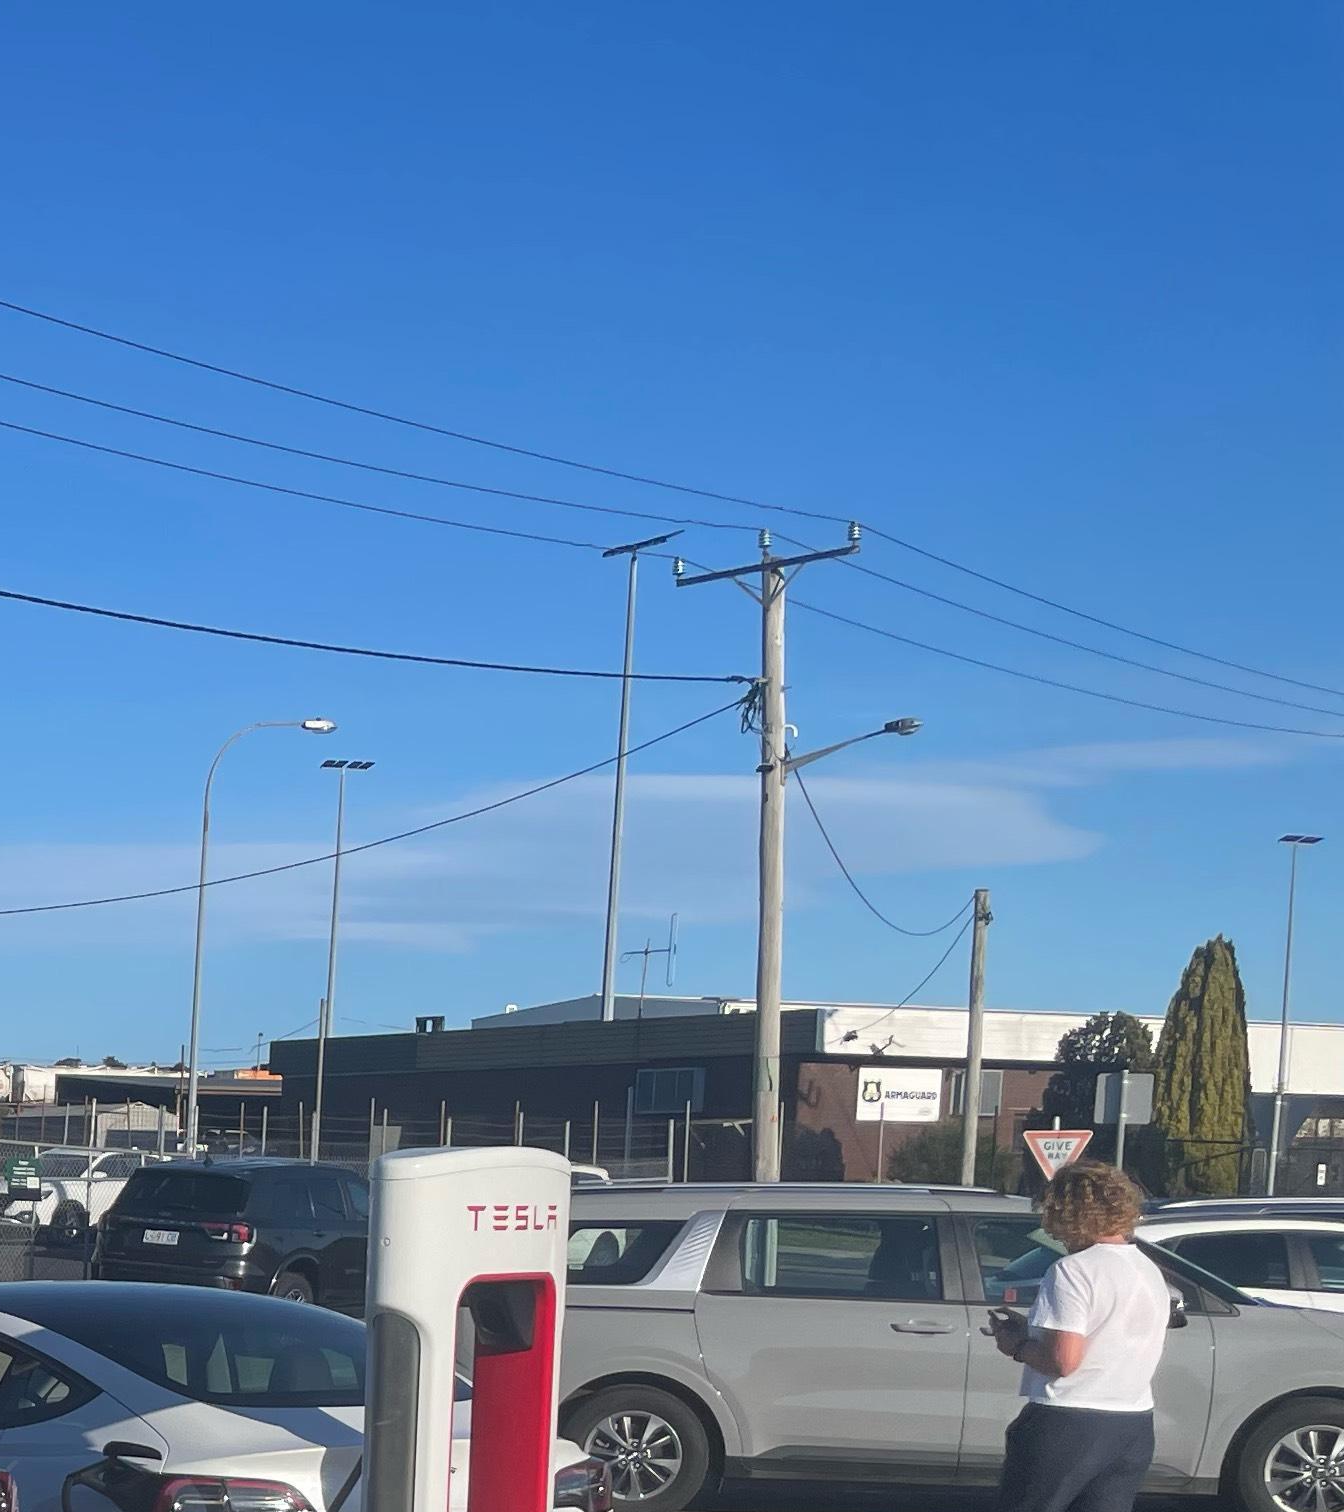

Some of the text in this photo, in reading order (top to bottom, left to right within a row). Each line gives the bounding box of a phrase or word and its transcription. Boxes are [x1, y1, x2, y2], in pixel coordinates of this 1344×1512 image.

[884, 1090, 938, 1100] ARMAGUARD
[1043, 1141, 1073, 1151] GIVE
[1047, 1152, 1068, 1160] WAY
[466, 1205, 557, 1232] TESLA
